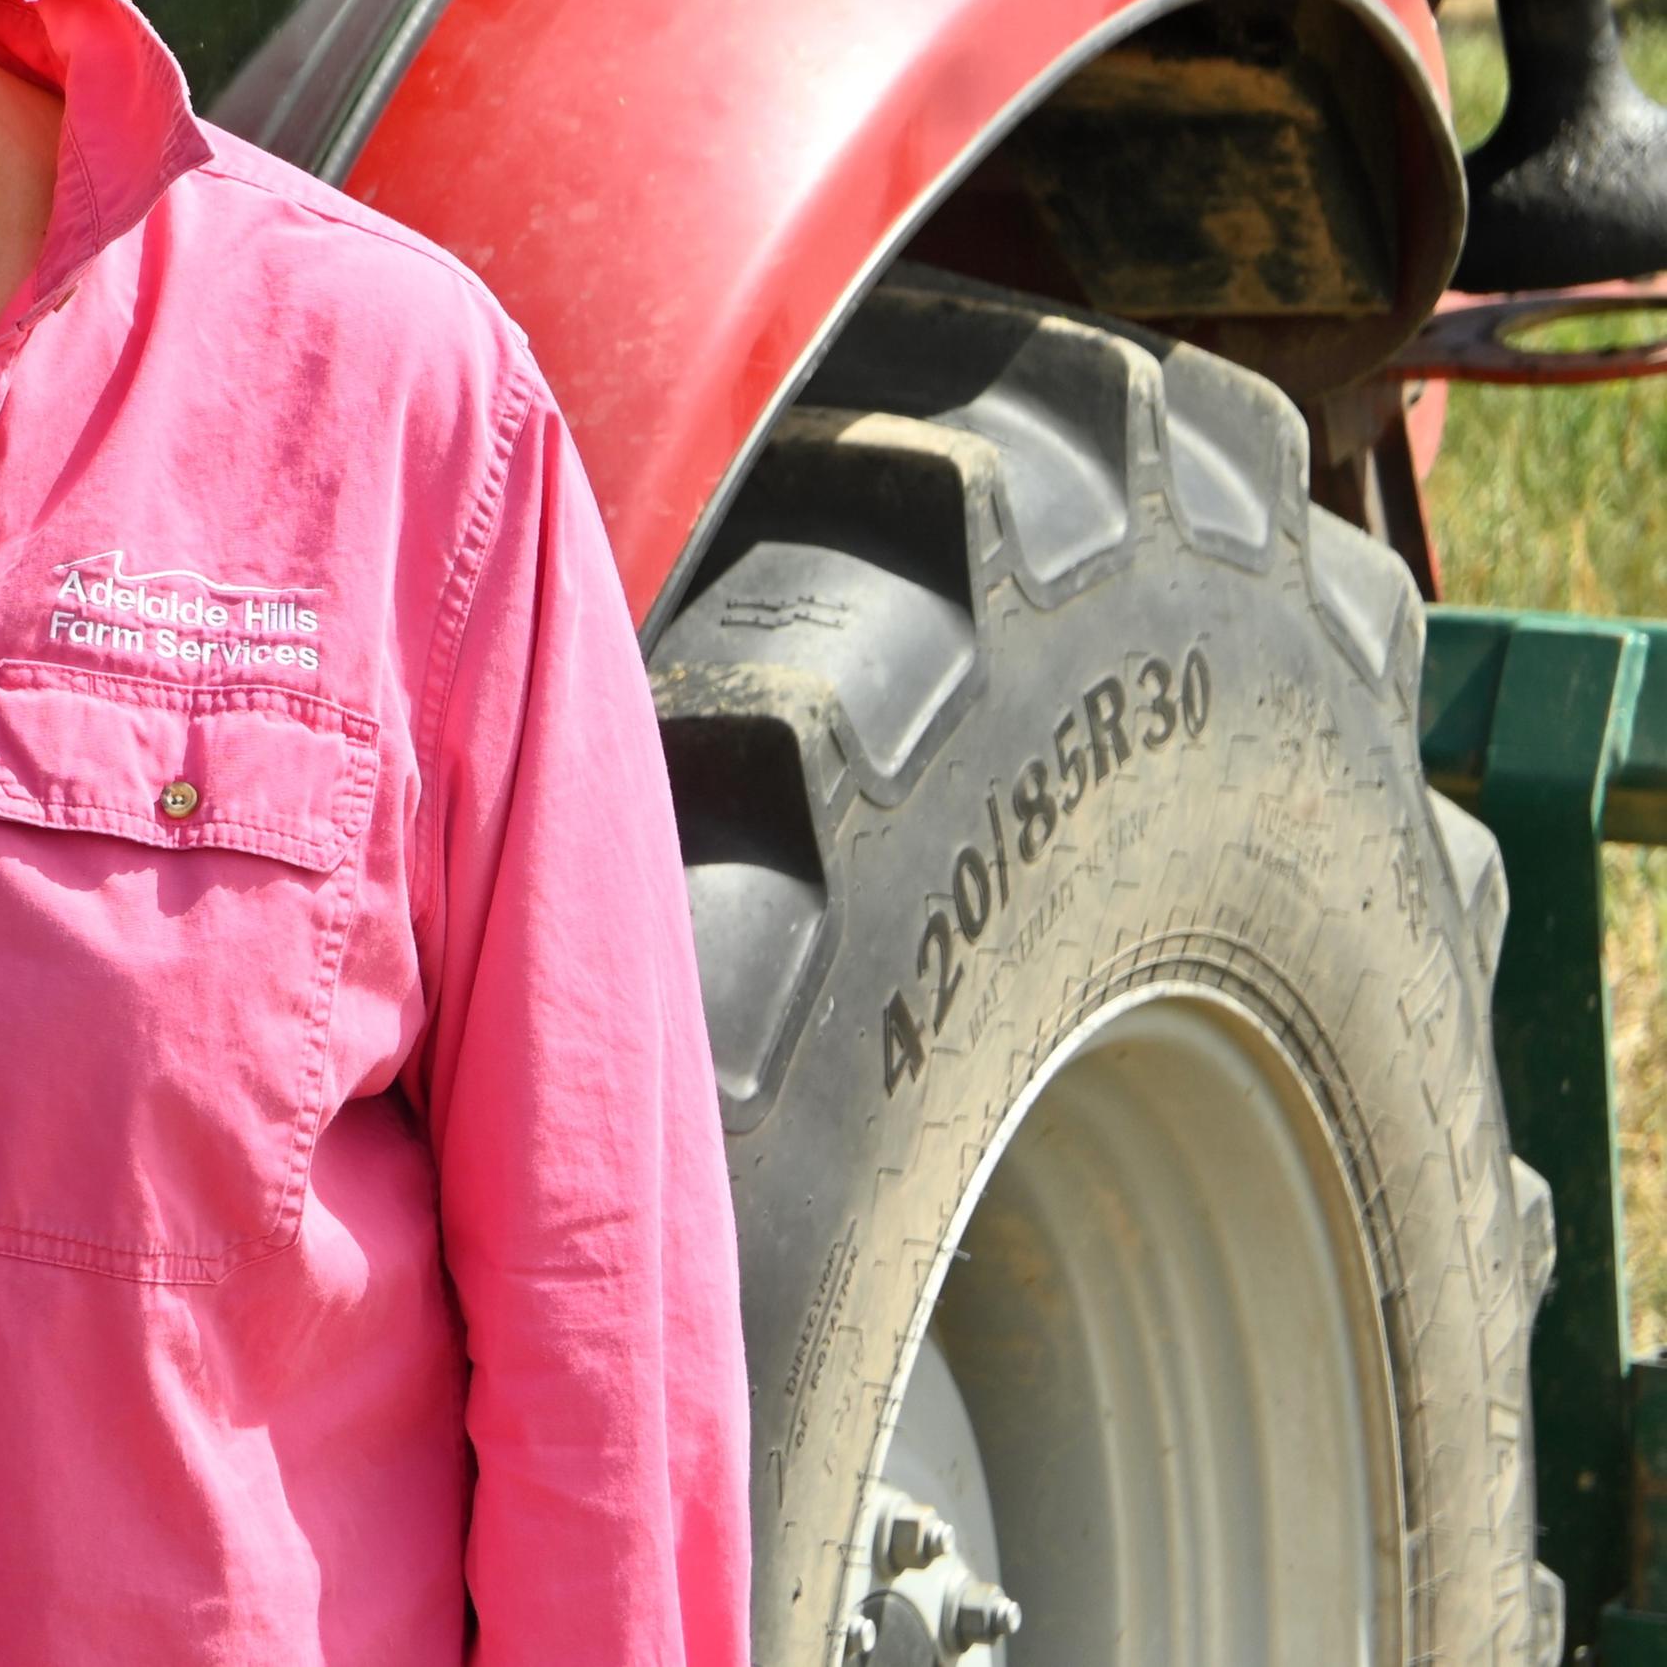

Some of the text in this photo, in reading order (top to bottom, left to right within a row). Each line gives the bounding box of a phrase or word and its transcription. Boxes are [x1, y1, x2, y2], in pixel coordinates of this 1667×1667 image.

[49, 610, 320, 671] Farm Services
[57, 570, 319, 633] Adelaide Hills
[880, 646, 1211, 1099] 420/85R30
[784, 1242, 845, 1398] DIRECTION
[794, 1406, 809, 1449] OF
[809, 1245, 859, 1391] ROTATION
